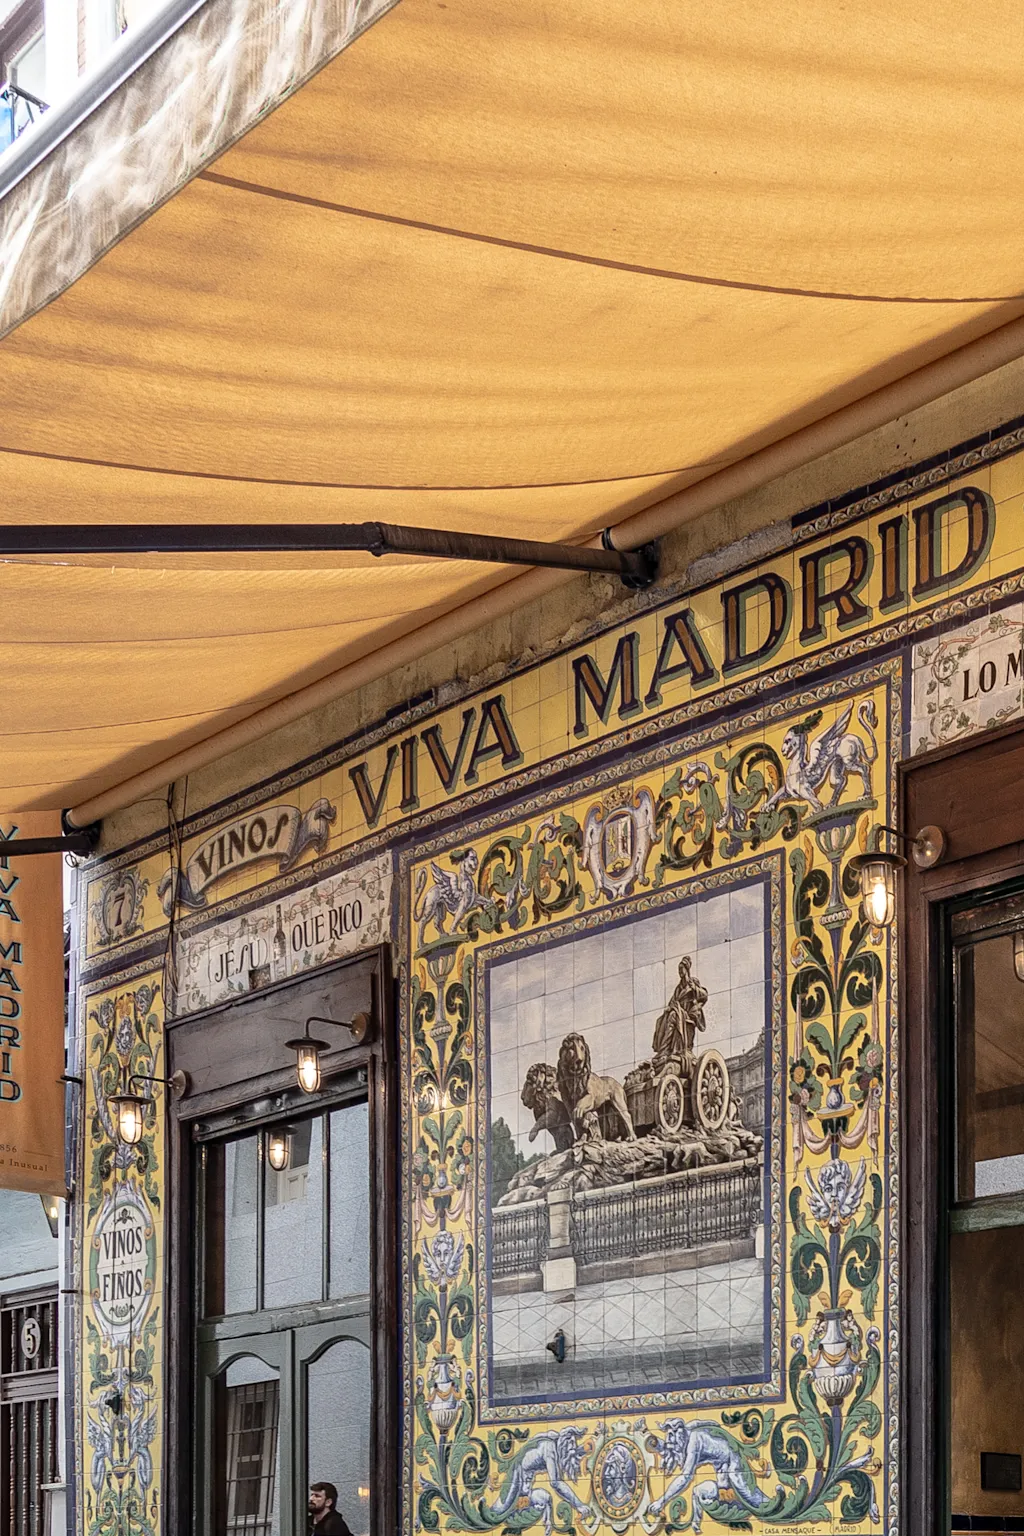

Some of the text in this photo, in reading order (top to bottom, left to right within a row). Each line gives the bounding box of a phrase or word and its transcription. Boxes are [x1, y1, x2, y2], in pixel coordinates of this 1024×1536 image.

[348, 485, 996, 829] VIVA MADRID
[961, 660, 996, 702] LO
[195, 813, 288, 880] VINOS
[113, 892, 126, 927] 7
[328, 899, 362, 940] RICO
[9, 1158, 48, 1172] Inusual
[103, 1227, 142, 1259] VINOS
[103, 1269, 142, 1301] FINOS
[26, 1323, 36, 1355] 5
